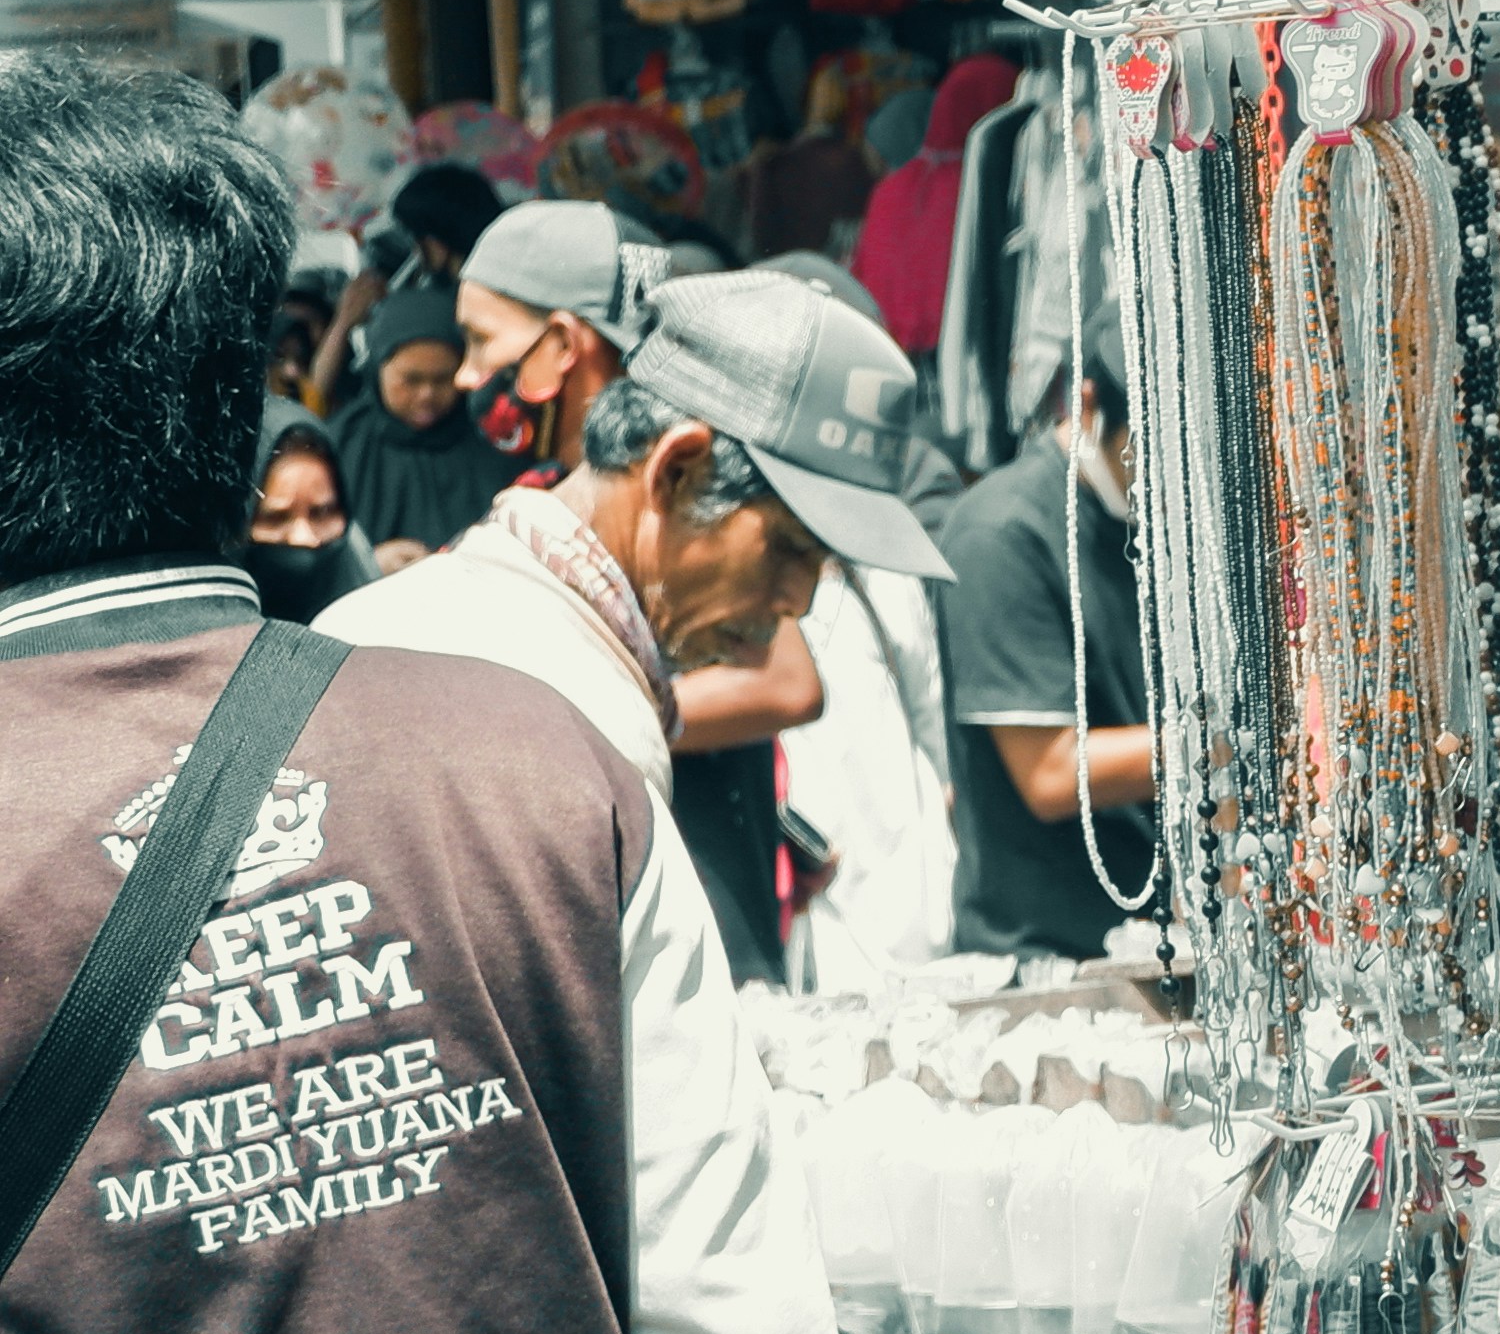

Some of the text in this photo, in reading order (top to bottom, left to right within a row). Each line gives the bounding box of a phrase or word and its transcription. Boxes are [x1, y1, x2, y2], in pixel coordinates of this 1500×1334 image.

[1306, 21, 1362, 43] Trend
[168, 880, 372, 995] EEP
[140, 941, 424, 1071] CALM
[98, 1078, 522, 1223] MARDI YUANA
[148, 1039, 444, 1157] WE ARE
[191, 1147, 448, 1254] FAMILY
